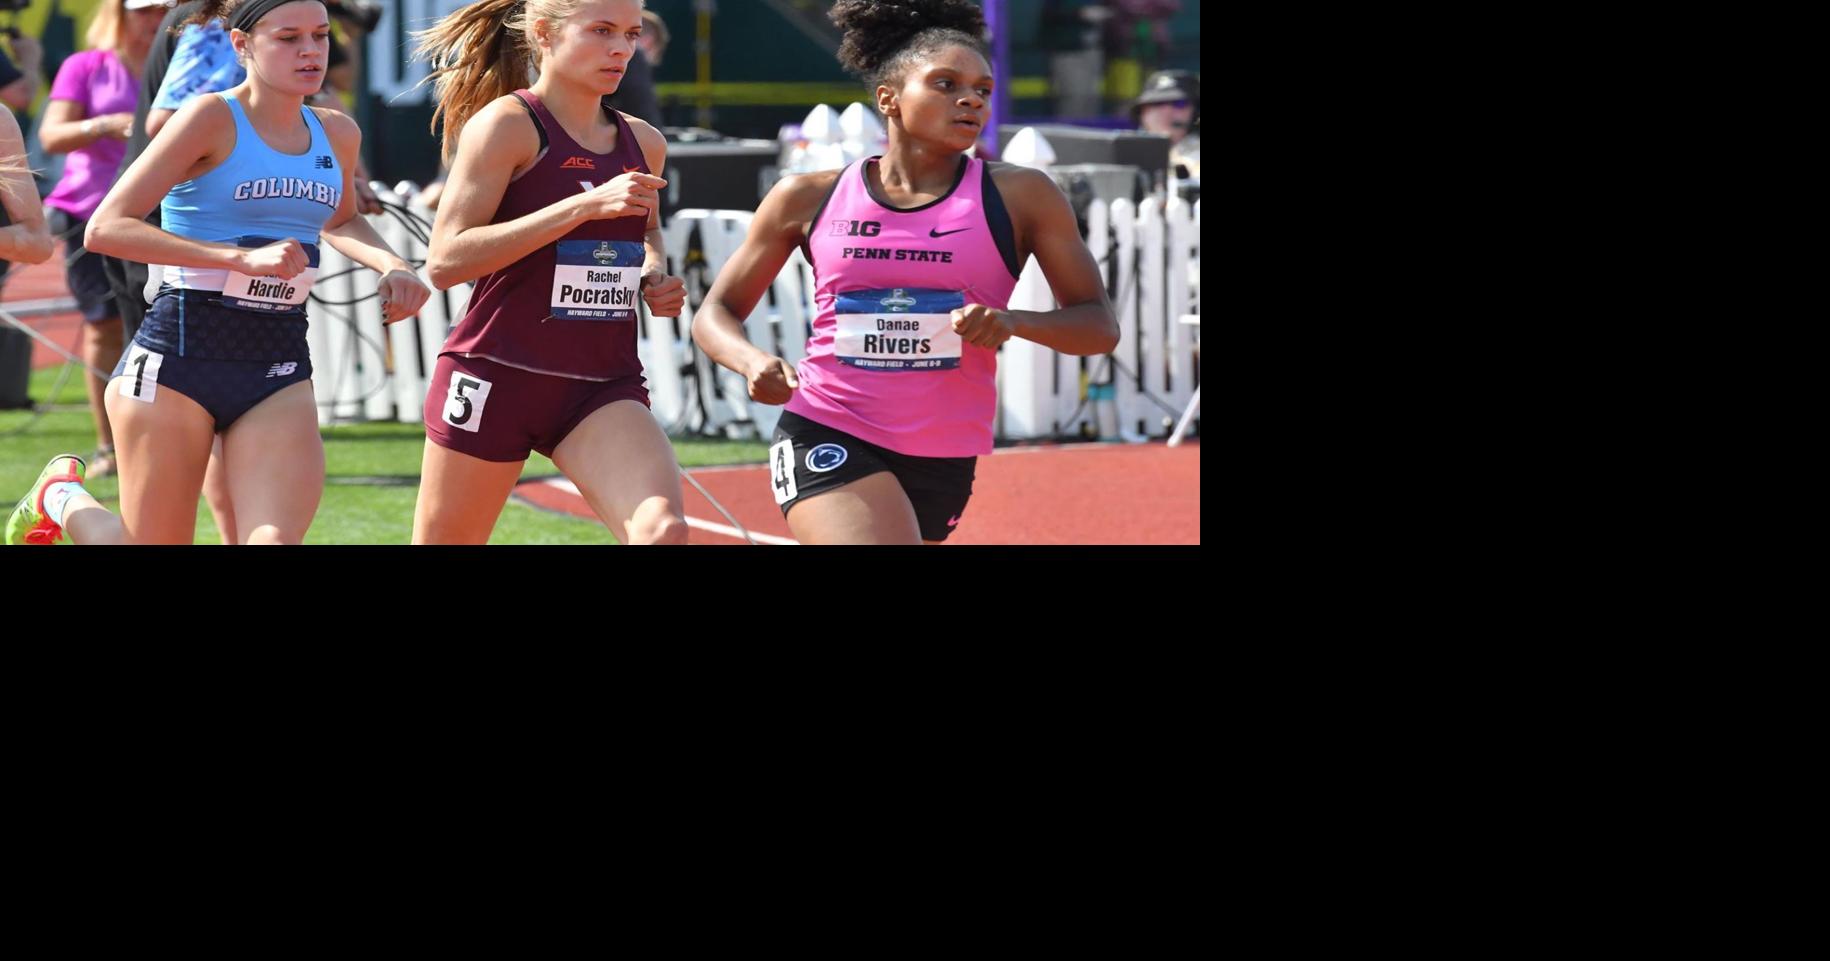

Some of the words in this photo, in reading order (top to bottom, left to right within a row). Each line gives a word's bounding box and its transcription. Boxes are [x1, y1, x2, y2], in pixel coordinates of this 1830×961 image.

[560, 156, 596, 169] ACC
[234, 177, 340, 210] COLUMBI
[842, 247, 892, 260] PENN
[895, 250, 953, 263] STATE
[587, 270, 621, 283] Rachel
[247, 279, 295, 300] Hardie
[560, 284, 634, 307] Pocratsky
[567, 309, 592, 317] HAYWARD
[876, 318, 919, 331] Danae
[864, 334, 931, 354] Rivers
[854, 359, 885, 367] HAYWARD
[886, 360, 904, 368] FIELD
[133, 353, 150, 397] 1
[449, 377, 480, 425] 5
[775, 446, 790, 497] 4
